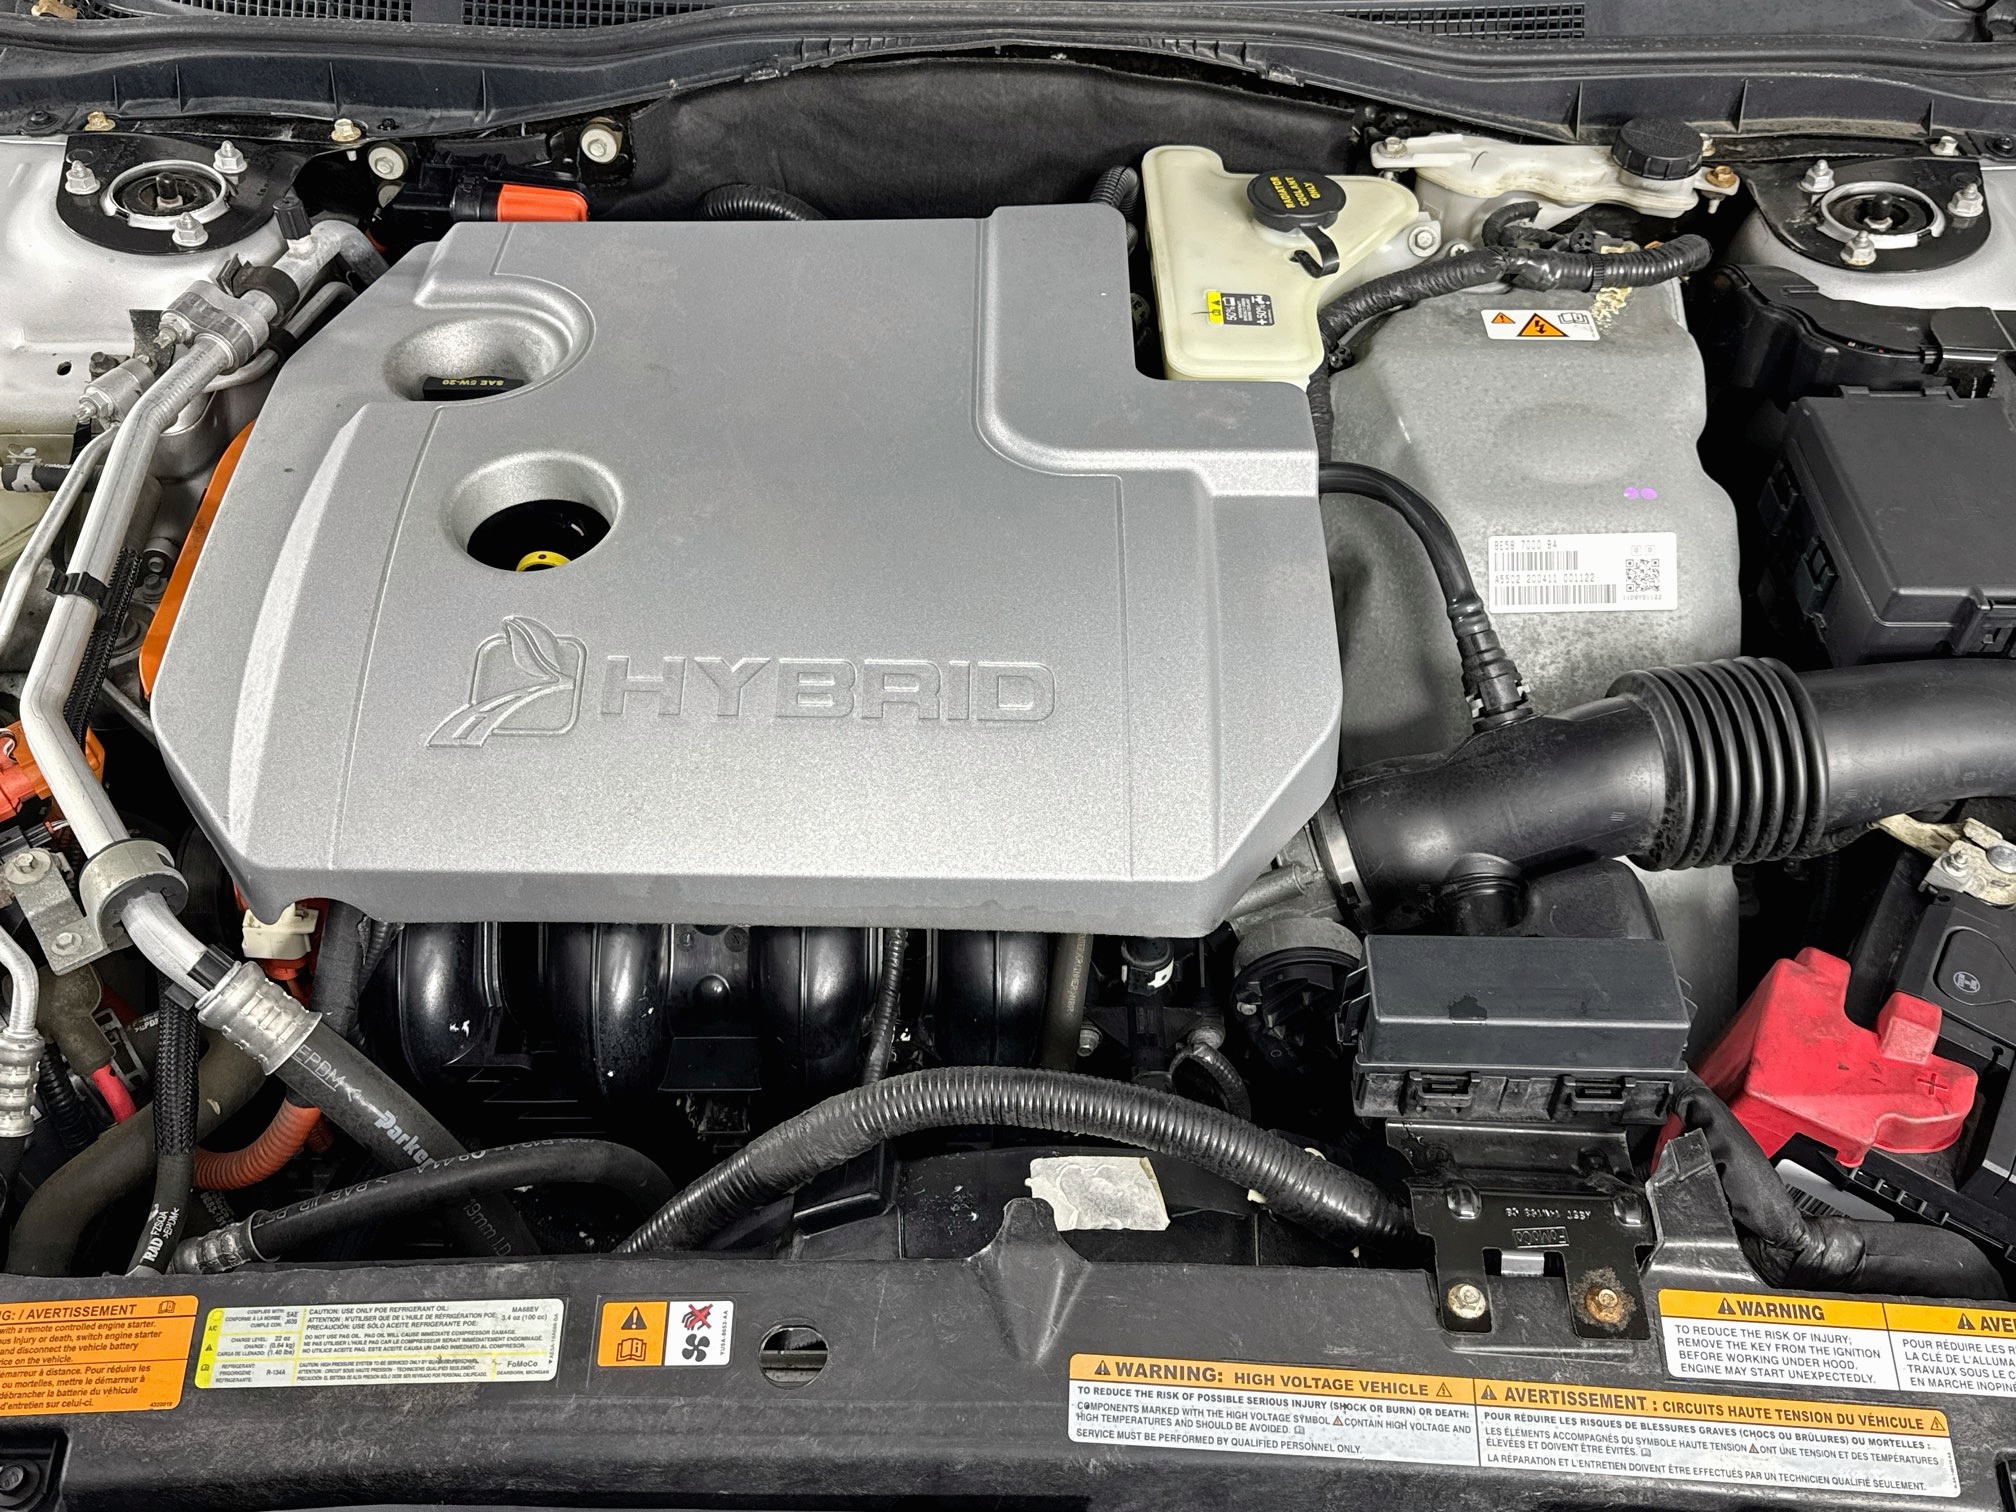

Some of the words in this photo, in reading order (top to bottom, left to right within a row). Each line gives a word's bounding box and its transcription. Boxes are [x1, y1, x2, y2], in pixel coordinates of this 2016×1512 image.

[1270, 176, 1296, 209] RADIATOR
[1284, 176, 1310, 207] COOLANT
[1303, 182, 1321, 200] ONLY
[602, 656, 1057, 721] HYBRID
[463, 1198, 496, 1240] 19mm
[142, 1238, 163, 1262] RAD
[26, 1304, 137, 1320] AVERTISSEMENT
[1736, 1300, 1825, 1321] WARNING
[0, 1326, 17, 1334] with
[23, 1324, 54, 1333] remote
[53, 1323, 96, 1332] controlled
[96, 1322, 126, 1332] engine
[126, 1320, 157, 1329] starter.
[1674, 1325, 1690, 1335] TO
[1692, 1326, 1738, 1338] REDUCE
[1740, 1329, 1762, 1339] THE
[1764, 1330, 1790, 1341] RISK
[1792, 1332, 1808, 1342] OF
[1810, 1333, 1853, 1345] INJURY;
[16, 1344, 62, 1354] disconnect
[62, 1344, 77, 1352] the
[77, 1343, 108, 1352] vehicle
[108, 1342, 140, 1353] battery
[1677, 1338, 1723, 1350] REMOVE
[1726, 1340, 1747, 1351] THE
[1750, 1342, 1772, 1352] KEY
[1774, 1343, 1806, 1354] FROM
[1809, 1345, 1830, 1356] THE
[1832, 1347, 1882, 1359] IGNITION
[1902, 1339, 1933, 1350] POUR
[1935, 1339, 1982, 1353] RÉDUIRE
[1984, 1344, 2006, 1354] LES
[1904, 1352, 1919, 1361] LA
[1920, 1350, 1943, 1363] CLÉ
[1944, 1354, 1960, 1364] DE
[1679, 1350, 1723, 1362] BEFORE
[1725, 1353, 1779, 1365] WORKING
[1781, 1356, 1820, 1367] UNDER
[1822, 1359, 1859, 1370] HOOD.
[1115, 1362, 1223, 1383] WARNING:
[1234, 1372, 1275, 1386] HIGH
[1280, 1375, 1354, 1391] VOLTAGE
[1358, 1380, 1429, 1396] VEHICLE
[1680, 1363, 1722, 1375] ENGINE
[1724, 1366, 1747, 1376] MAY
[1749, 1367, 1784, 1378] START
[1787, 1370, 1877, 1384] UNEXPECTEDLY.
[1906, 1364, 1957, 1376] TRAVAUX
[1959, 1367, 1990, 1378] SOUS
[1991, 1369, 2007, 1379] LE
[1909, 1377, 1925, 1387] EN
[1927, 1378, 1975, 1390] MARCHE
[1077, 1386, 1091, 1395] TO
[1092, 1387, 1132, 1398] REDUCE
[1134, 1390, 1153, 1399] THE
[1156, 1391, 1179, 1401] RISK
[1181, 1392, 1194, 1402] OF
[1196, 1393, 1244, 1405] POSSIBLE
[1246, 1396, 1289, 1407] SERIOUS
[1291, 1399, 1327, 1410] INJURY
[1369, 1404, 1383, 1413] OR
[1385, 1404, 1416, 1416] BURN)
[1418, 1407, 1432, 1416] OR
[1434, 1408, 1470, 1418] DEATH:
[1505, 1386, 1647, 1410] AVERTISSEMENT
[1662, 1401, 1724, 1416] CIRCUITS
[1727, 1406, 1771, 1420] HAUTE
[1774, 1409, 1833, 1424] TENSION
[1836, 1413, 1855, 1425] DU
[1858, 1413, 1925, 1430] VÉHICULE
[1077, 1402, 1139, 1413] COMPONENTS
[1140, 1405, 1180, 1416] MARKED
[1181, 1408, 1204, 1417] WITH
[1205, 1409, 1224, 1418] THE
[1225, 1410, 1248, 1420] HIGH
[1249, 1412, 1291, 1422] VOLTAGE
[1292, 1414, 1331, 1425] SYMBOL
[1344, 1418, 1383, 1428] CONTAIN
[1384, 1420, 1408, 1430] HIGH
[1409, 1422, 1450, 1432] VOLTAGE
[1452, 1424, 1472, 1434] AND
[1077, 1413, 1099, 1422] HIGH
[1101, 1414, 1172, 1427] TEMPERATURES
[1173, 1418, 1194, 1428] AND
[1195, 1419, 1233, 1430] SHOULD
[1234, 1422, 1247, 1431] BE
[1248, 1422, 1291, 1434] AVOIDED.
[1076, 1428, 1115, 1439] SERVICE
[1116, 1431, 1141, 1440] MUST
[1143, 1432, 1156, 1441] BE
[1158, 1433, 1215, 1445] PERFORMED
[1216, 1437, 1229, 1446] BY
[1230, 1438, 1279, 1449] QUALIFIED
[1280, 1441, 1335, 1452] PERSONNEL
[1336, 1444, 1363, 1454] ONLY.
[1484, 1412, 1511, 1422] POUR
[1513, 1412, 1556, 1425] RÉDUIRE
[1558, 1417, 1577, 1426] LES
[1579, 1418, 1622, 1429] RISQUES
[1624, 1421, 1637, 1430] DE
[1639, 1422, 1696, 1434] BLESSURES
[1698, 1426, 1737, 1437] GRAVES
[1738, 1428, 1776, 1440] (CHOCS
[1777, 1431, 1792, 1440] OU
[1794, 1430, 1849, 1445] BRÛLURES)
[1850, 1436, 1866, 1445] OU
[1867, 1437, 1925, 1449] MORTELLES
[1485, 1427, 1502, 1436] LES
[1503, 1426, 1551, 1439] ÉLÉMENTS
[1552, 1429, 1619, 1444] ACCOMPAGNÉS
[1620, 1436, 1634, 1445] DU
[1635, 1437, 1677, 1448] SYMBOLE
[1678, 1440, 1708, 1450] HAUTE
[1709, 1442, 1748, 1453] TENSION
[1759, 1446, 1777, 1455] ONT
[1778, 1447, 1797, 1456] UNE
[1798, 1448, 1836, 1459] TENSION
[1837, 1450, 1849, 1460] ET
[1850, 1451, 1868, 1461] DES
[1870, 1450, 1940, 1465] TEMPÉRATURES
